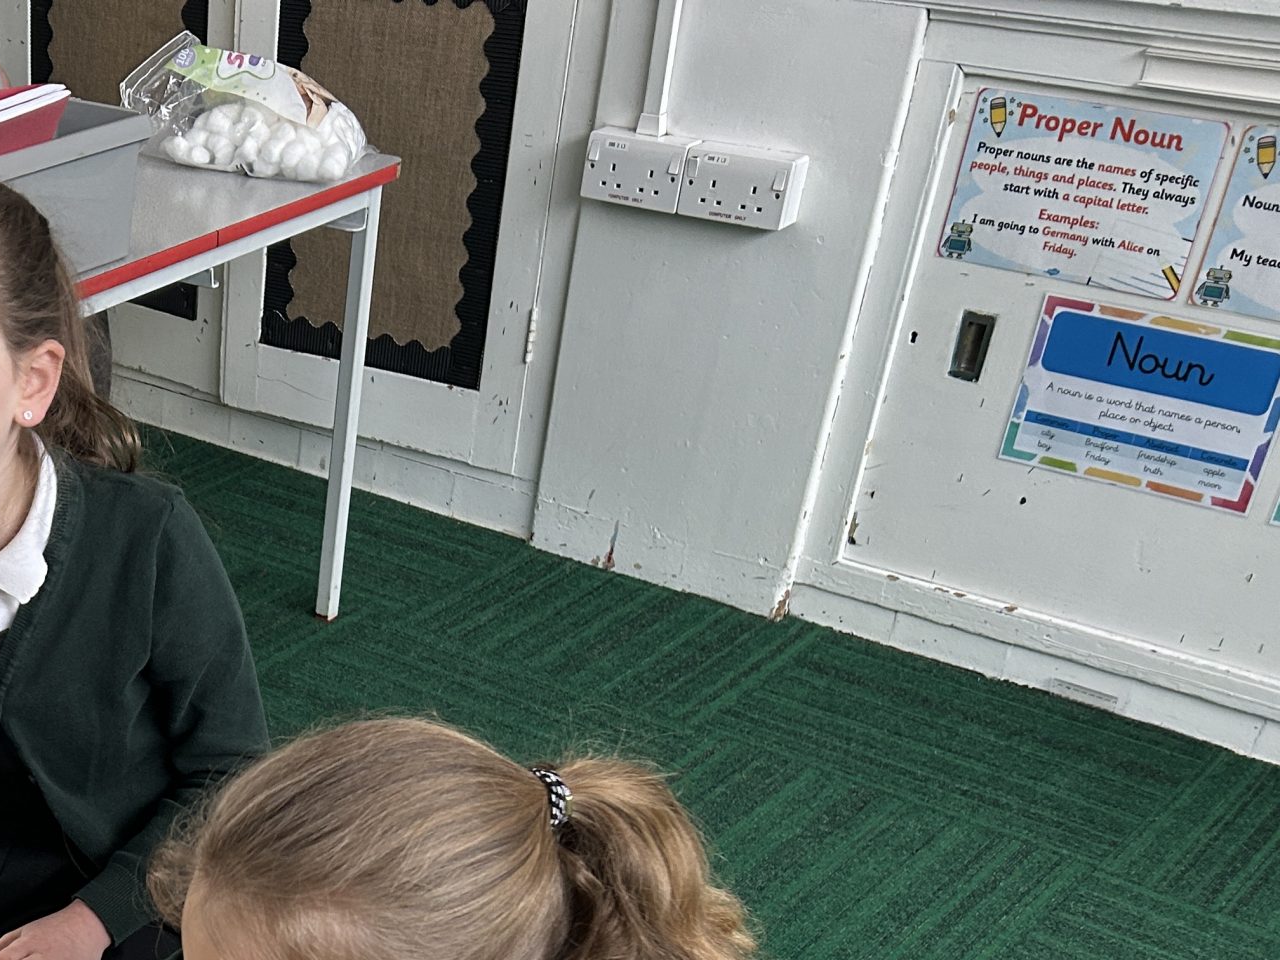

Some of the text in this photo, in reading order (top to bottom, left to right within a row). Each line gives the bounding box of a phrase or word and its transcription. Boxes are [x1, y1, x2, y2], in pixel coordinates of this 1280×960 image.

[1018, 103, 1183, 151] Proper Noun
[977, 142, 1199, 189] Proper nouns are the names of specific
[970, 161, 1195, 207] people, things and places. They always
[1003, 183, 1031, 195] start
[1034, 188, 1059, 199] with
[1073, 196, 1113, 208] capital
[1116, 199, 1148, 214] letter.
[709, 211, 731, 219] COMPUTER
[1039, 208, 1099, 230] Examples:
[972, 214, 1160, 256] I am going to Germany with Alice on
[1043, 241, 1077, 259] Friday.
[1230, 248, 1253, 267] My
[1107, 331, 1214, 387] Noun
[1046, 382, 1053, 391] A
[1057, 387, 1082, 398] noun
[1107, 399, 1133, 409] word
[1135, 402, 1156, 414] that
[1158, 408, 1192, 421] names
[1204, 419, 1240, 433] person,
[1099, 409, 1127, 421] place
[1144, 418, 1174, 432] object.
[1041, 430, 1055, 440] city
[1037, 440, 1052, 451] boy
[1085, 438, 1119, 452] Bradford
[1085, 451, 1111, 465] Friday
[1137, 450, 1177, 468] friendship
[1144, 465, 1163, 476] truth
[1203, 468, 1226, 478] apple
[1198, 480, 1222, 490] moon
